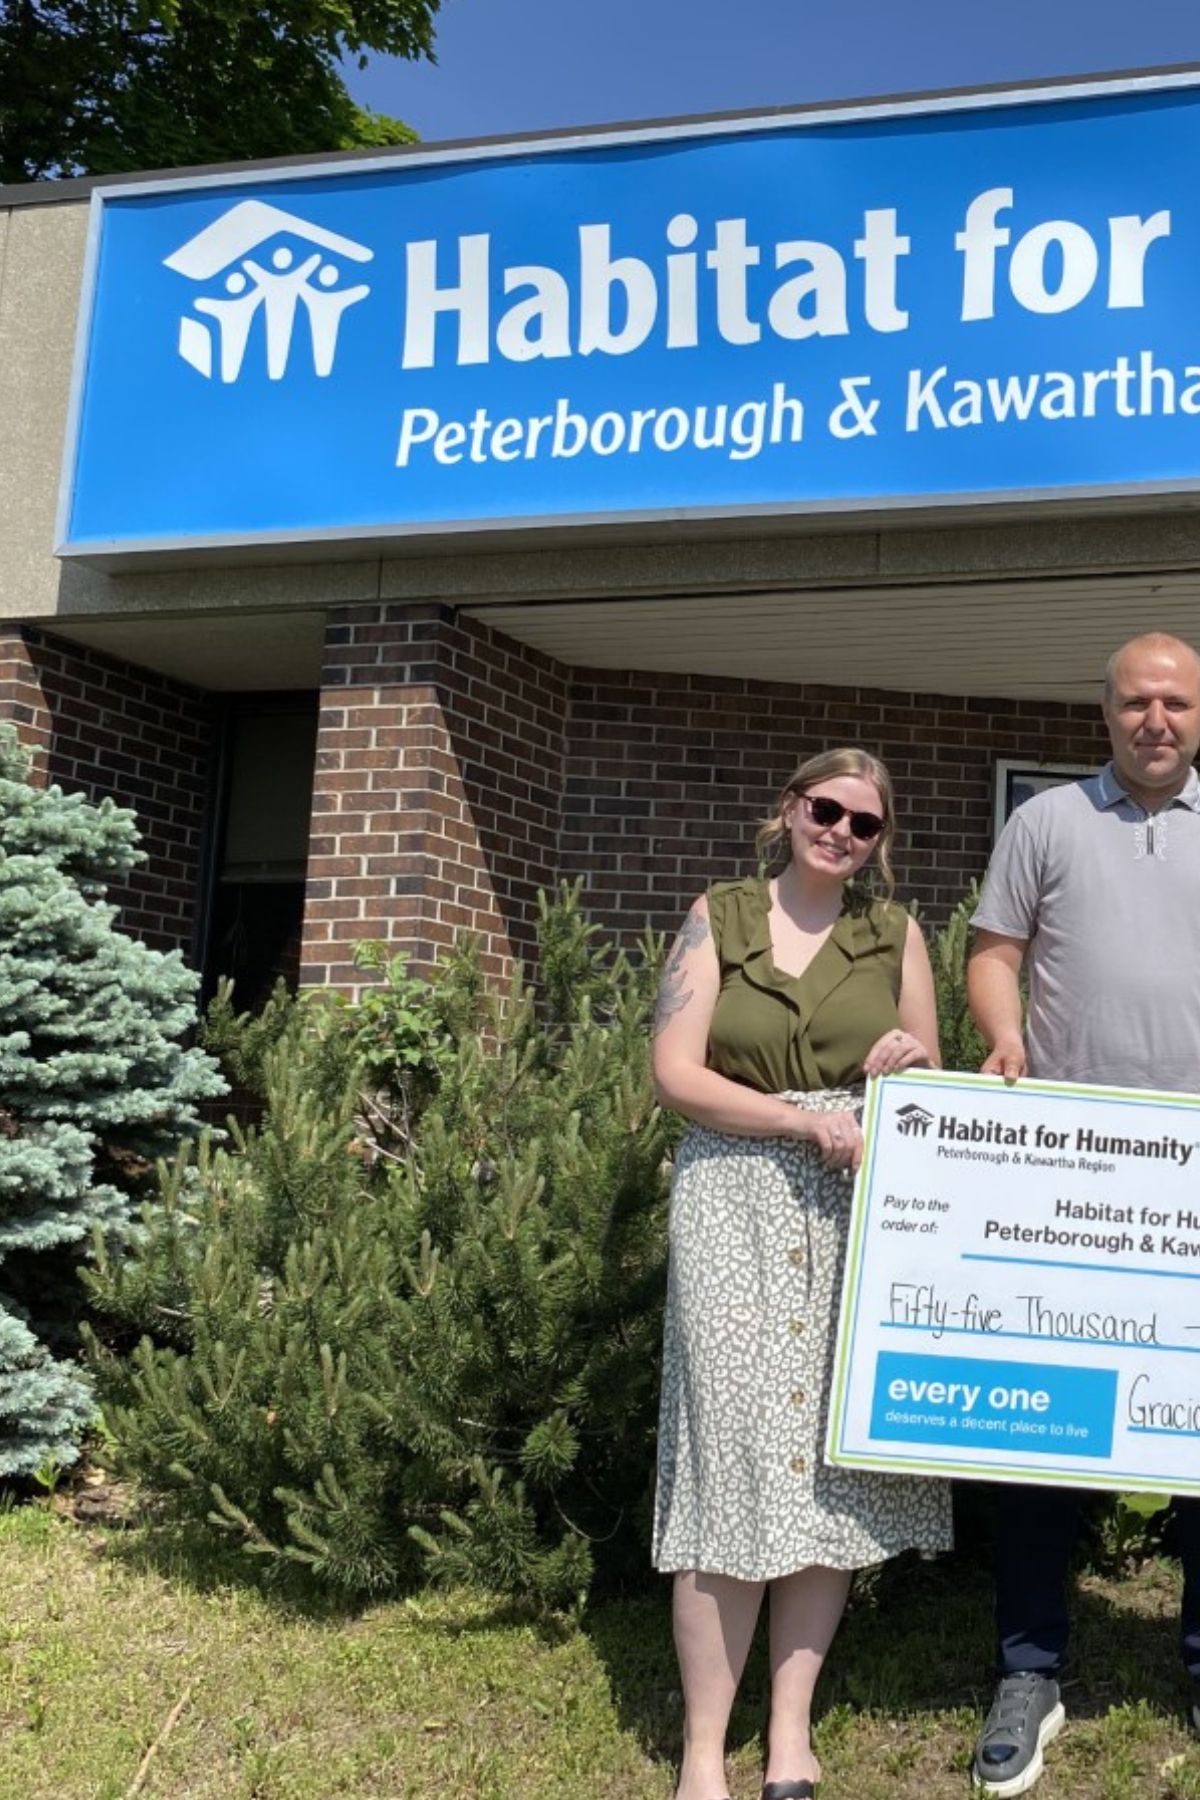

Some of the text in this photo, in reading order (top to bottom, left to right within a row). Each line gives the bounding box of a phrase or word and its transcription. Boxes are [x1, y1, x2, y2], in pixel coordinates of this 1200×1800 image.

[402, 207, 911, 370] Habitat
[954, 187, 1171, 322] for
[395, 382, 804, 468] Peterborough
[828, 375, 880, 440] &
[937, 1115, 1195, 1166] Habitat for Humanity
[937, 1145, 1116, 1174] Peterborough & Kawartha Region
[883, 1194, 951, 1215] Pay to the
[1055, 1198, 1134, 1224] Habitat
[1140, 1204, 1172, 1228] for
[881, 1218, 938, 1235] order of:
[984, 1220, 1134, 1254] Peterborough
[1139, 1232, 1156, 1254] &
[889, 1283, 1158, 1345] Fifty-five Thousand
[888, 1376, 1050, 1412] every one
[884, 1408, 1088, 1438] deserves a decent place to live
